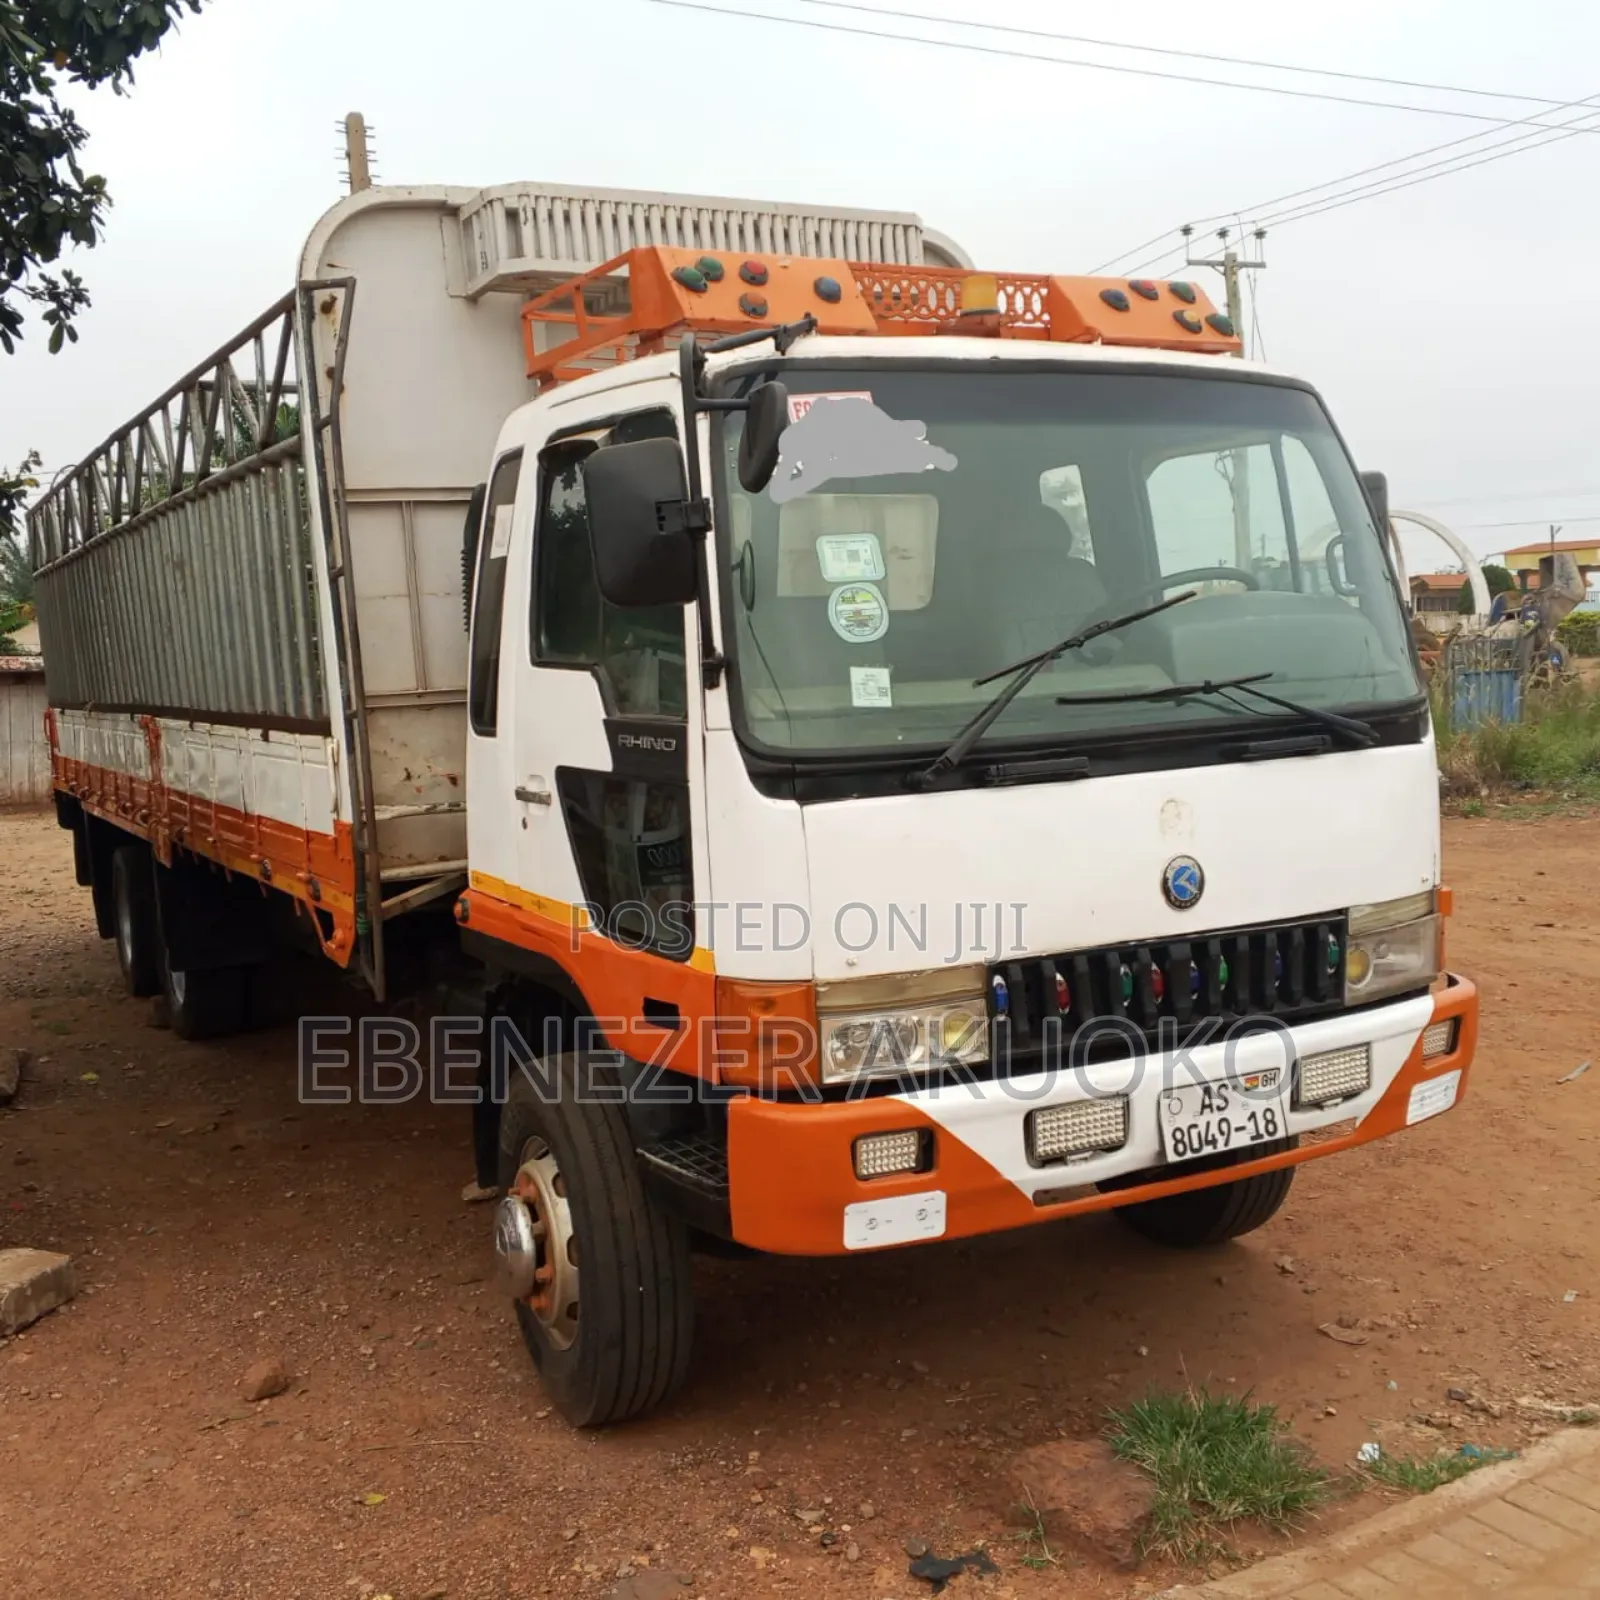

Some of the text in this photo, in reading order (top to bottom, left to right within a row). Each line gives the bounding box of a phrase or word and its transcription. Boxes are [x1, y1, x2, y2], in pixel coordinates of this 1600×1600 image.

[617, 734, 677, 751] RHINO
[1201, 1072, 1277, 1116] AS GH
[1171, 1107, 1278, 1157] 8049-18
